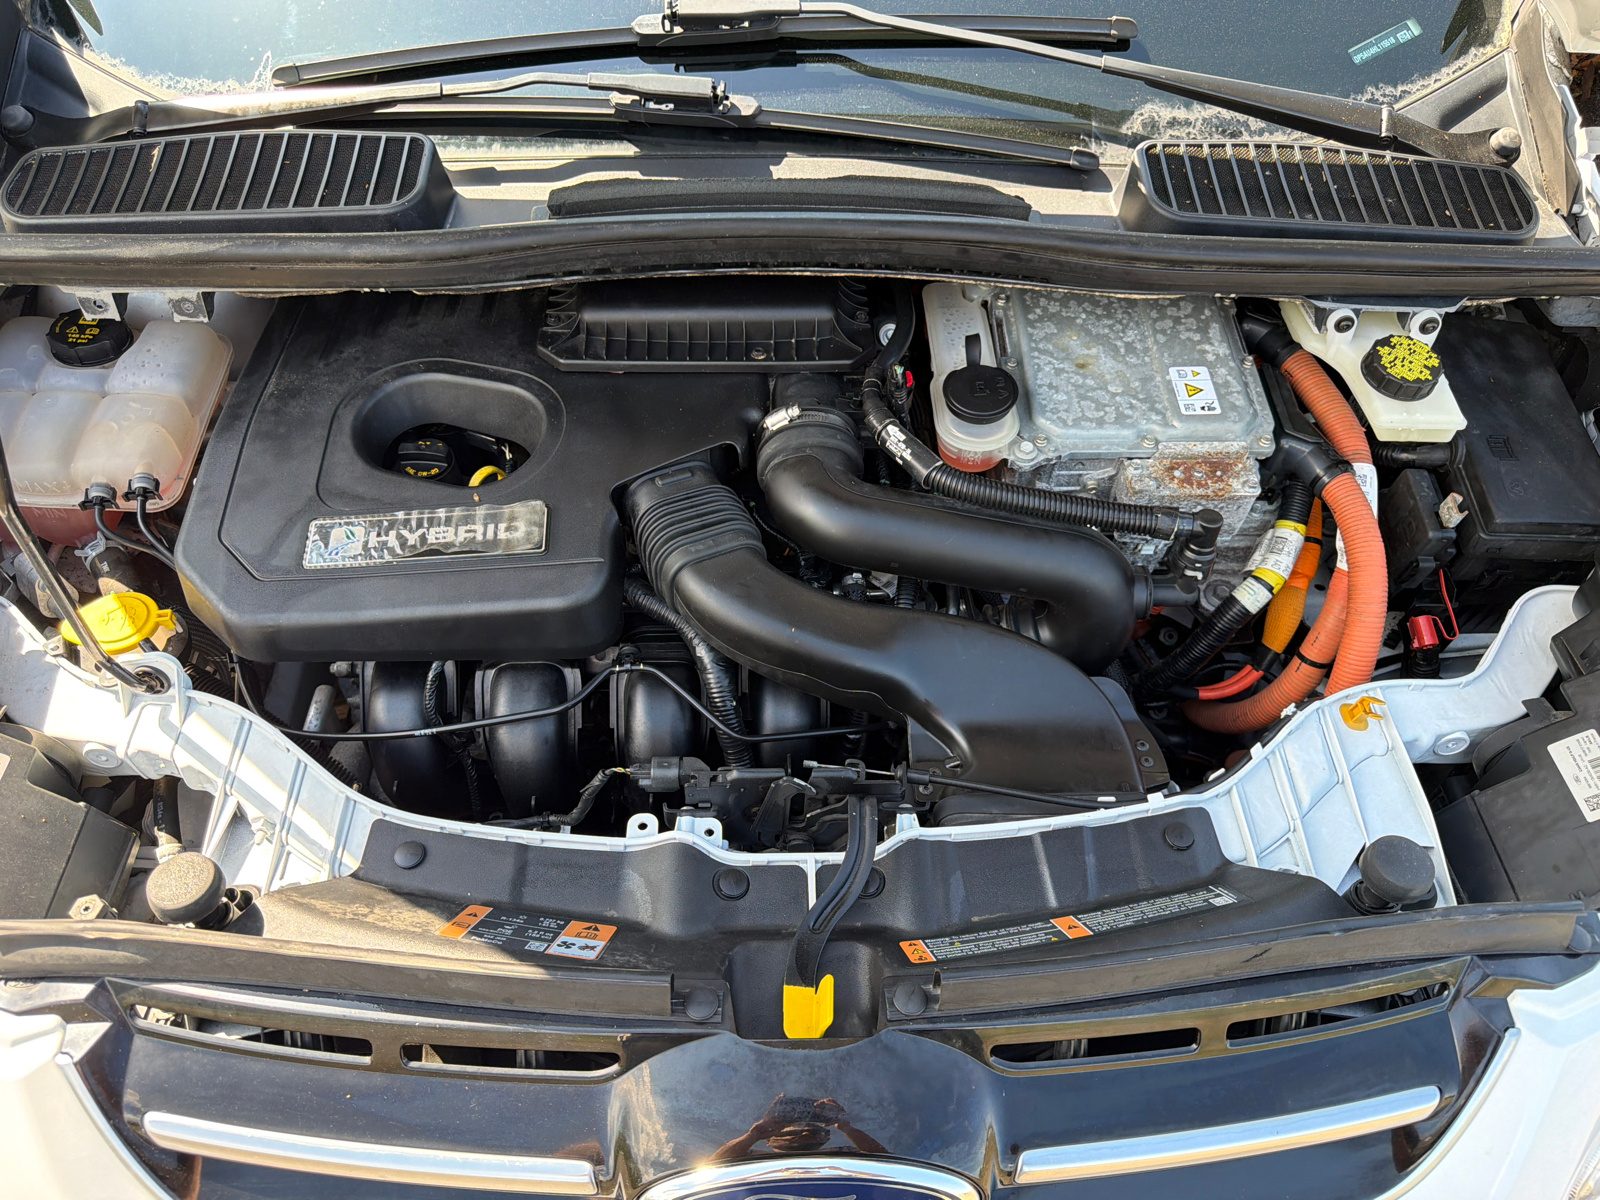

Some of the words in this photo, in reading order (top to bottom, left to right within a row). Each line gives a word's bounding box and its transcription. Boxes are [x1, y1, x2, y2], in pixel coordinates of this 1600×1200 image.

[418, 467, 439, 476] 0W-20
[32, 507, 68, 519] MIN
[367, 521, 525, 548] HYBRID
